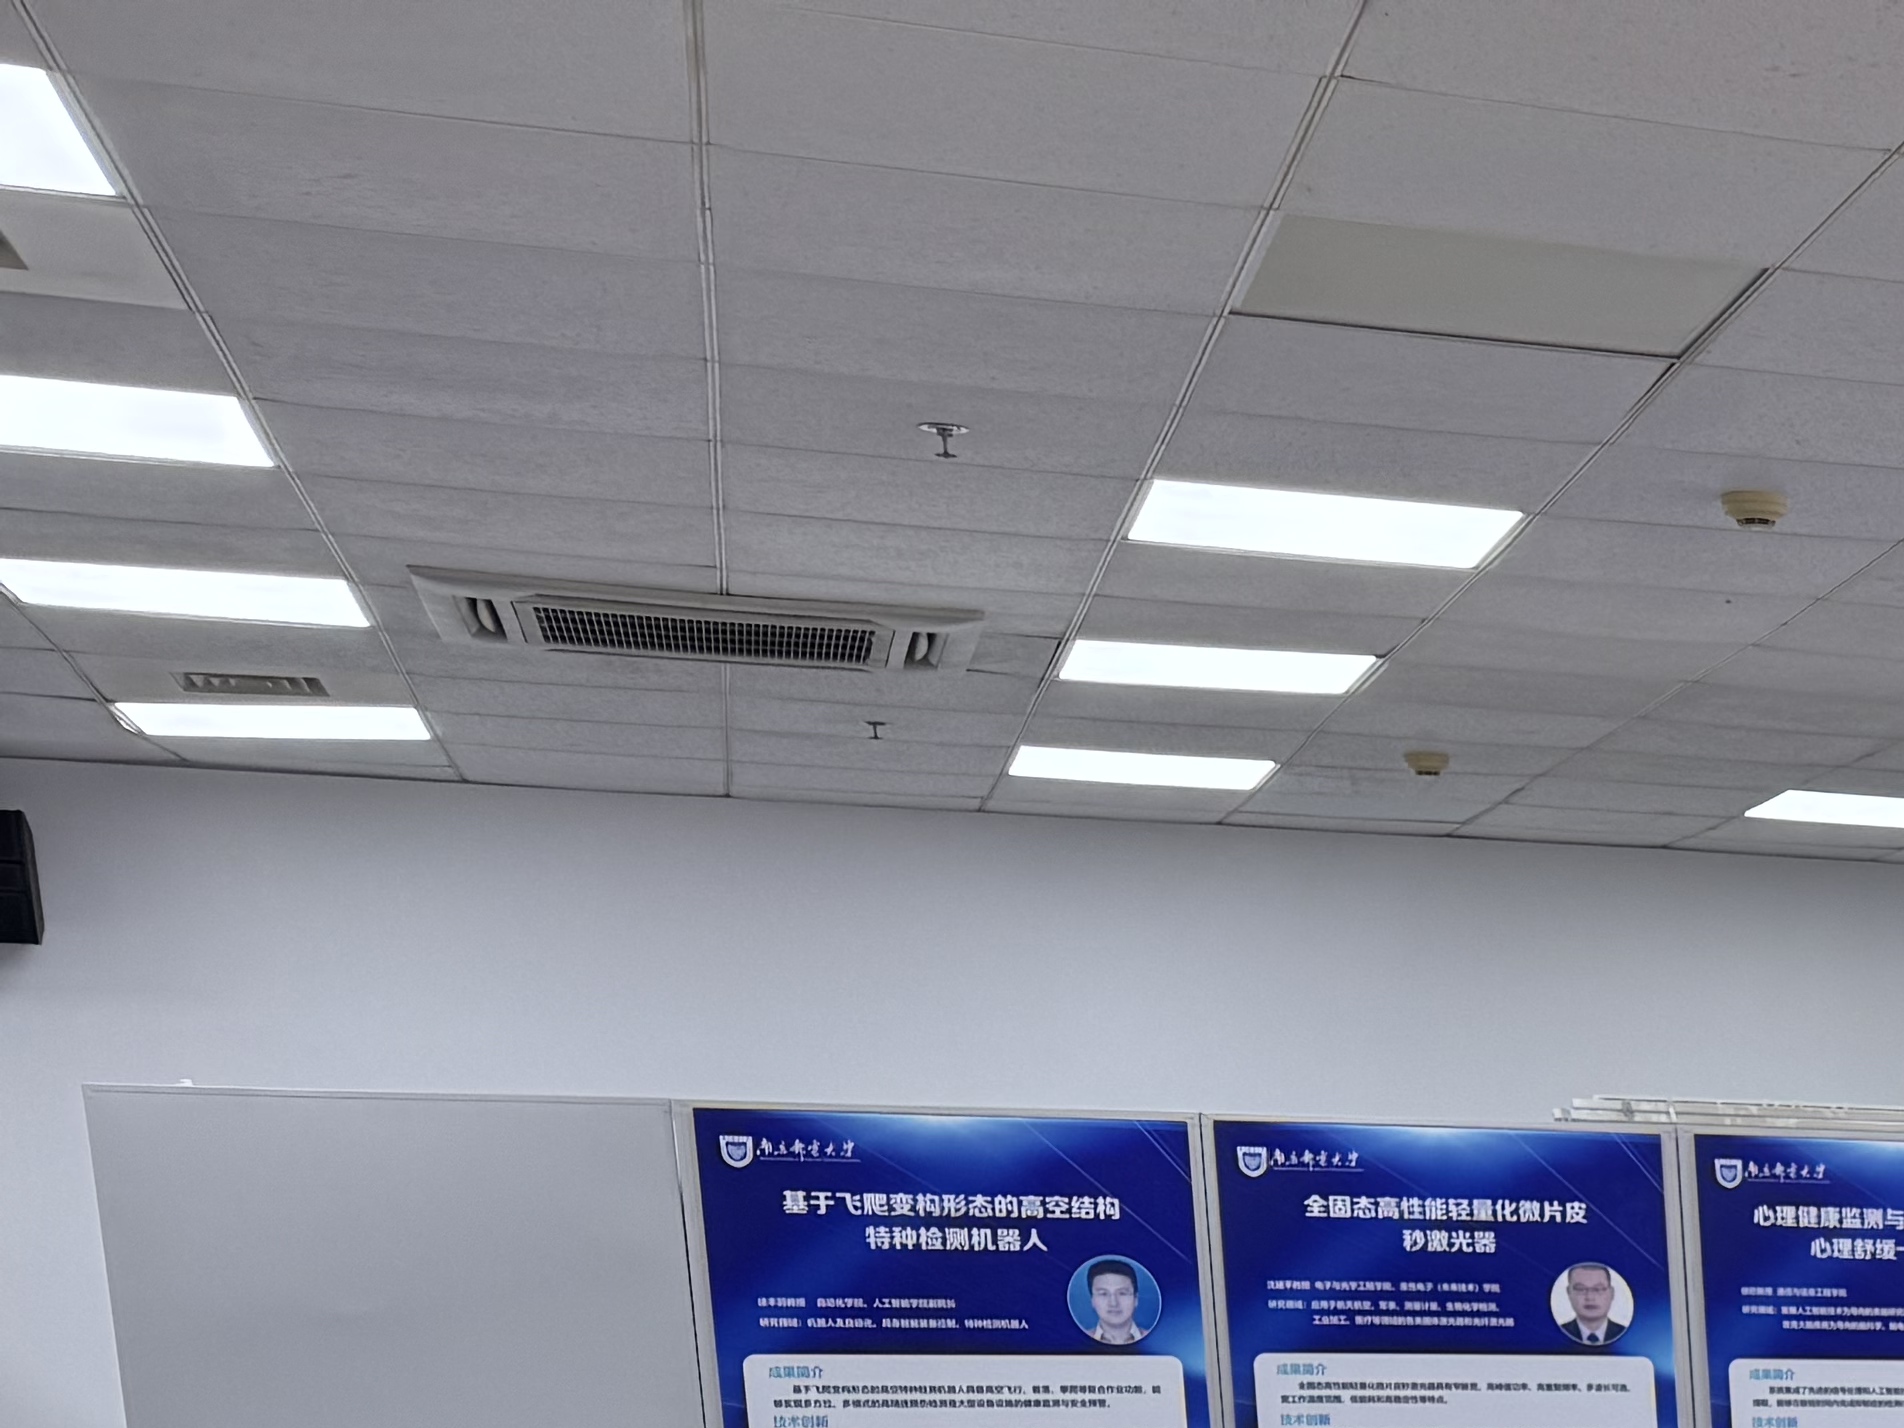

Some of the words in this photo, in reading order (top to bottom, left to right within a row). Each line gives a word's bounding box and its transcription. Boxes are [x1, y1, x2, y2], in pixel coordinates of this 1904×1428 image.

[782, 1190, 1120, 1221] 基于飞爬变构形态的高空结构
[1303, 1194, 1588, 1225] 全固态高性能轻量化微片皮
[865, 1226, 1048, 1252] 特种检测机器人
[1402, 1229, 1497, 1254] 秒激光器
[768, 1365, 824, 1380] 成果简介
[1276, 1363, 1327, 1376] 成果简介
[1749, 1369, 1795, 1382] 成果简介
[773, 1415, 829, 1428] 技术创新
[1280, 1413, 1331, 1427] 技术创新
[1751, 1416, 1798, 1428] 技术创新
